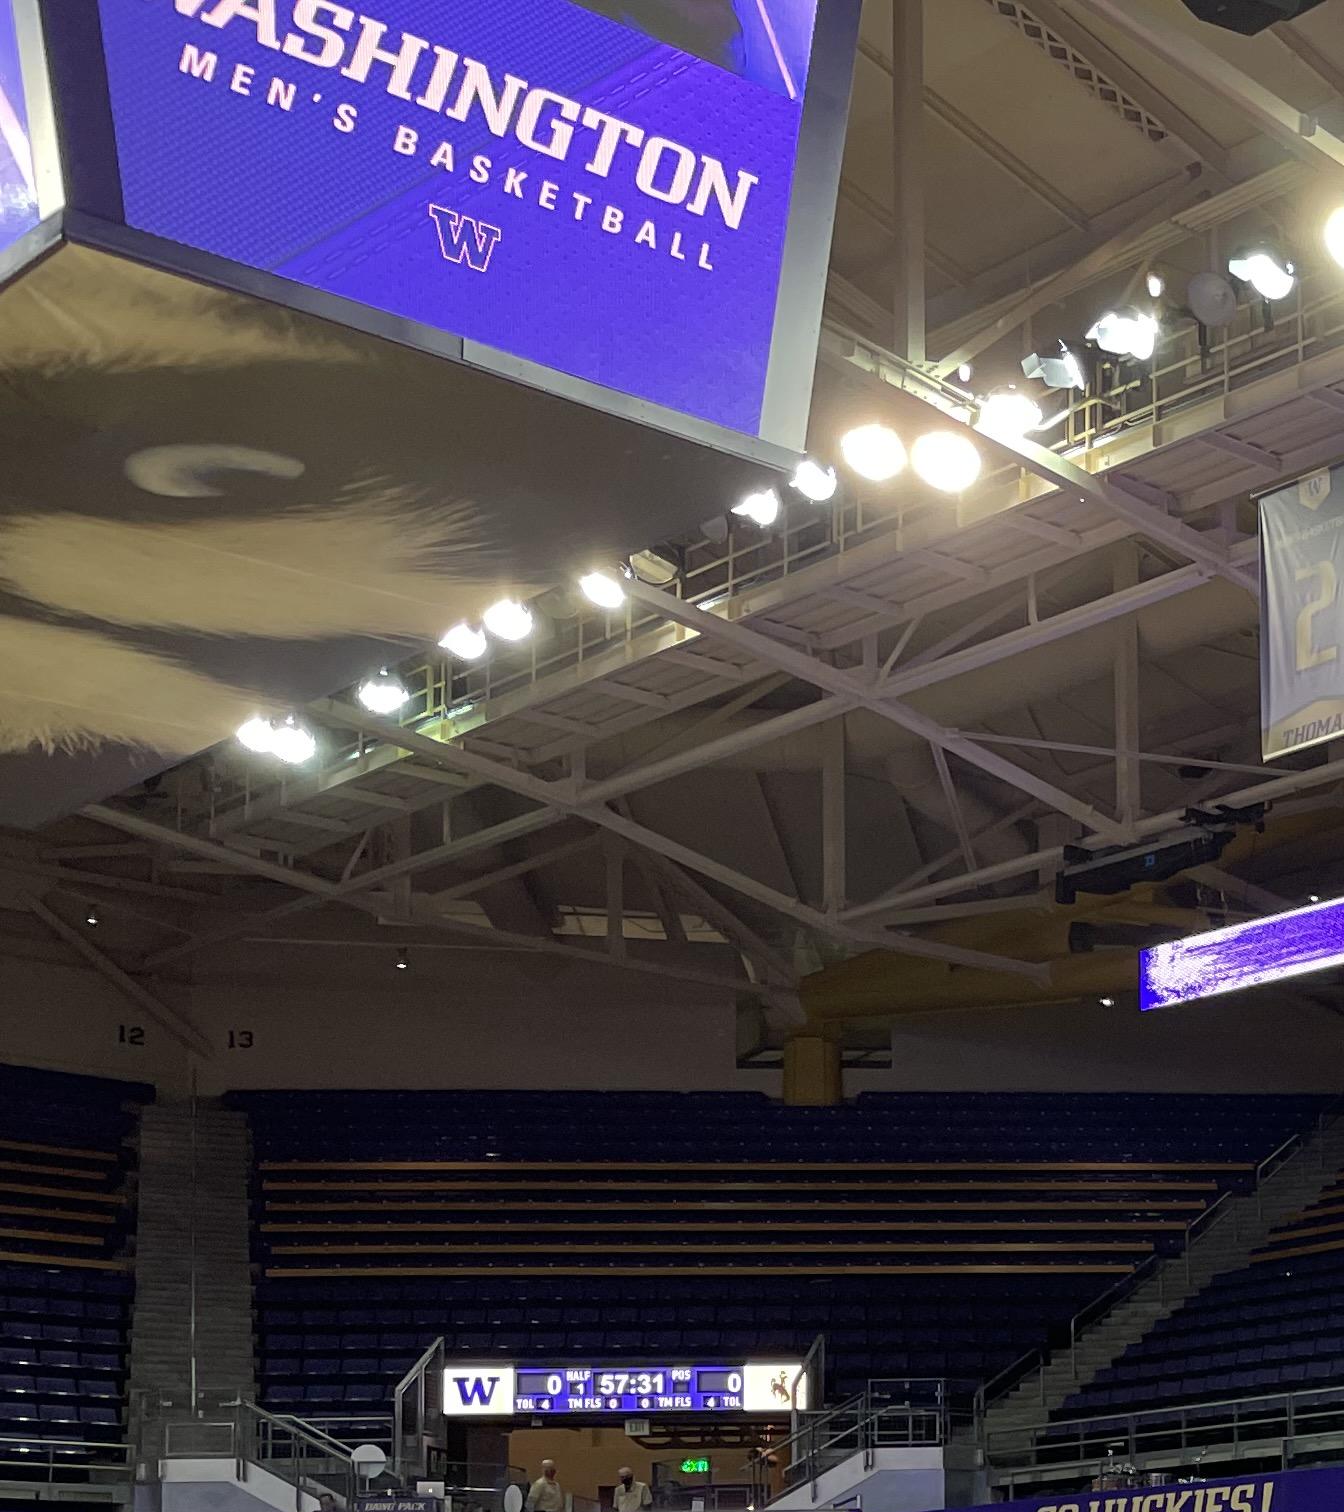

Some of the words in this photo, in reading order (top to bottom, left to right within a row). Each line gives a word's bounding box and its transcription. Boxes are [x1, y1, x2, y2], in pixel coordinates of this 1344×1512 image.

[178, 44, 359, 134] MEN'S
[393, 128, 716, 271] BASKETBALL
[430, 204, 502, 273] W
[1295, 560, 1337, 673] 2
[119, 1025, 145, 1045] 12
[228, 1030, 254, 1048] 13
[566, 1370, 591, 1381] HALF
[600, 1374, 664, 1395] 57:31
[671, 1369, 691, 1381] POS
[727, 1373, 742, 1393] 0
[453, 1377, 500, 1406] W
[547, 1375, 562, 1395] 0
[576, 1383, 585, 1395] 1
[516, 1399, 535, 1410] TOL
[541, 1399, 550, 1410] 4
[567, 1399, 583, 1409] TM
[585, 1398, 601, 1409] FLS
[657, 1397, 673, 1408] TM
[675, 1397, 691, 1408] FLS
[723, 1396, 741, 1407] TOL
